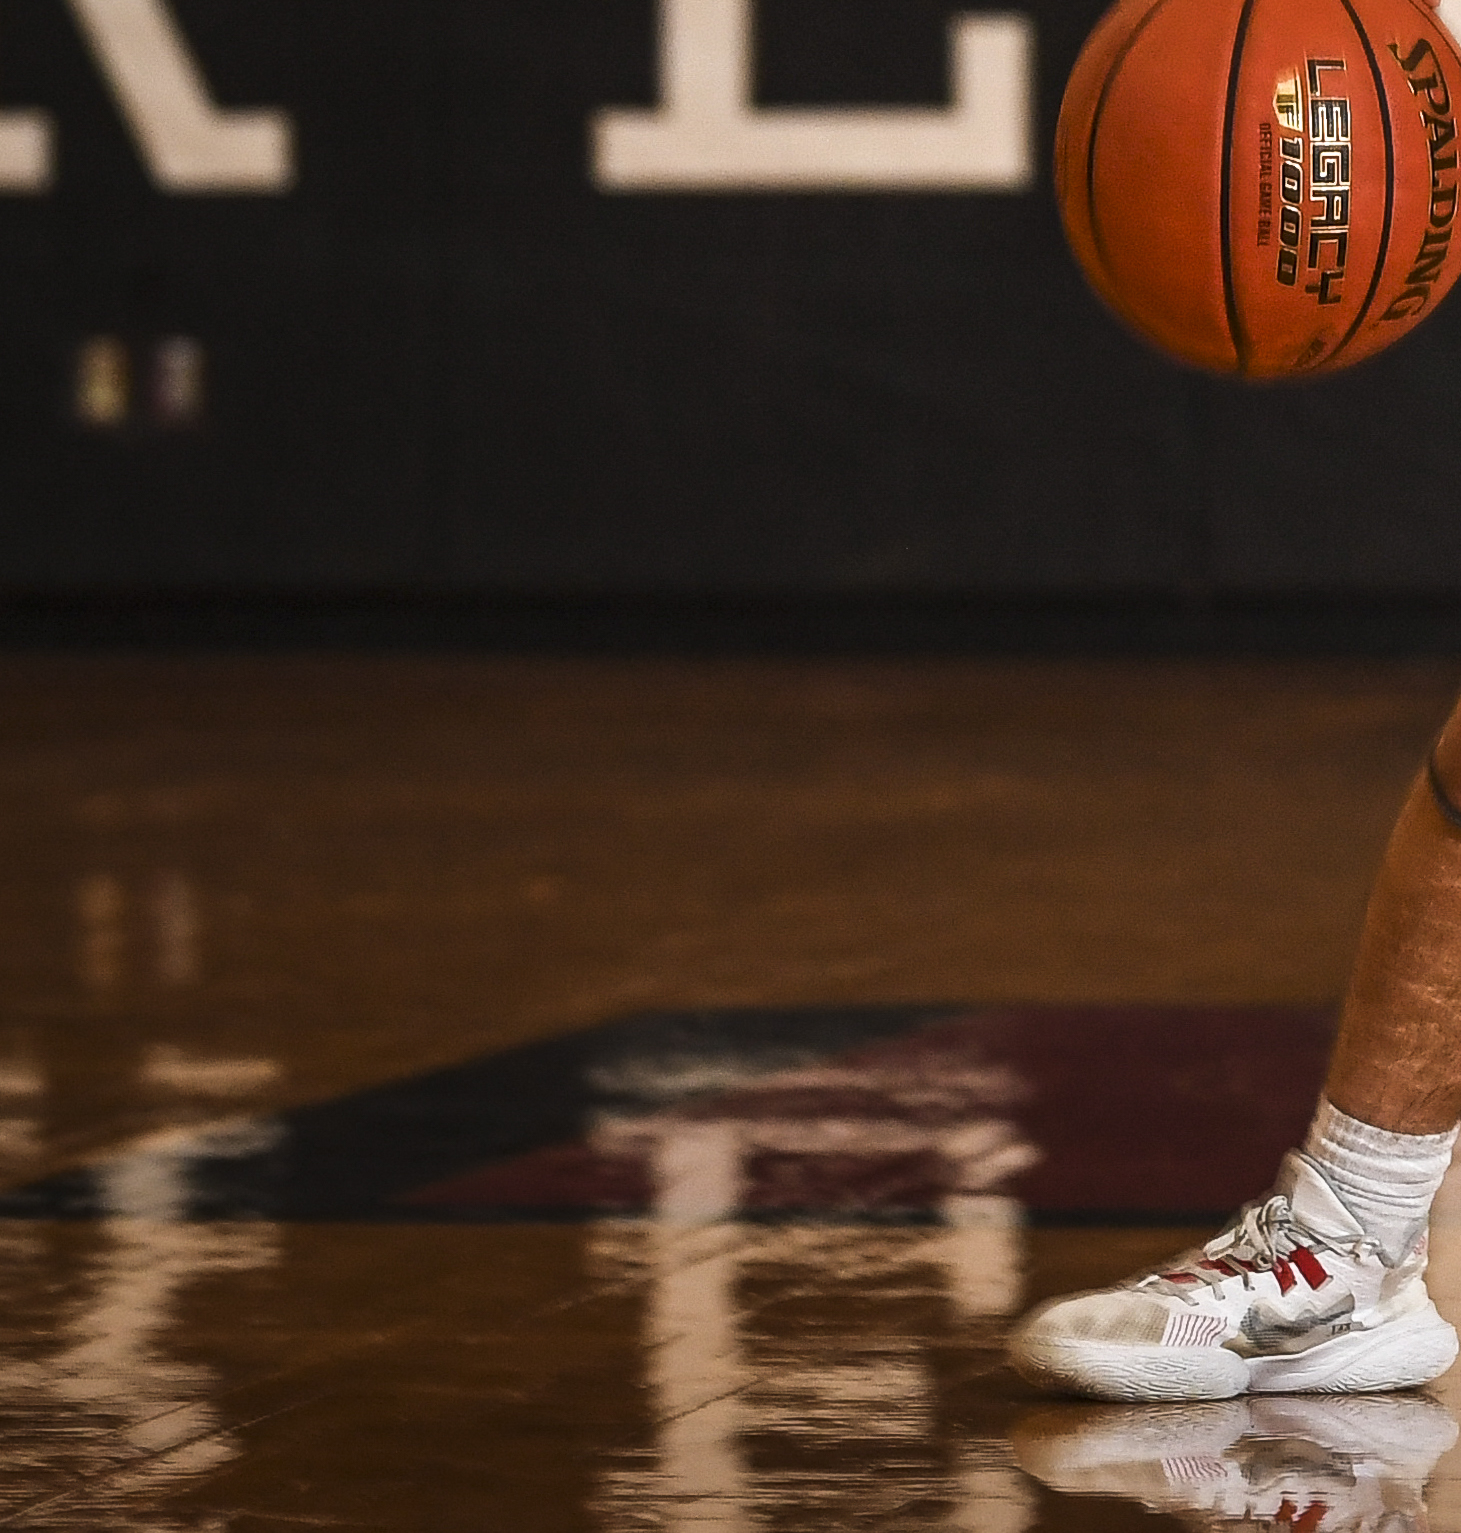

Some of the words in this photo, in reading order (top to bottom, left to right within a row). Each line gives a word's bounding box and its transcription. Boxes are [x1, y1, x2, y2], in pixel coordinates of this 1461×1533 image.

[1258, 122, 1273, 180] OFFICIAL
[1381, 37, 1460, 322] SPALDING
[1257, 181, 1272, 216] GAME
[1304, 56, 1351, 306] LEGACY
[1256, 219, 1271, 248] BALL
